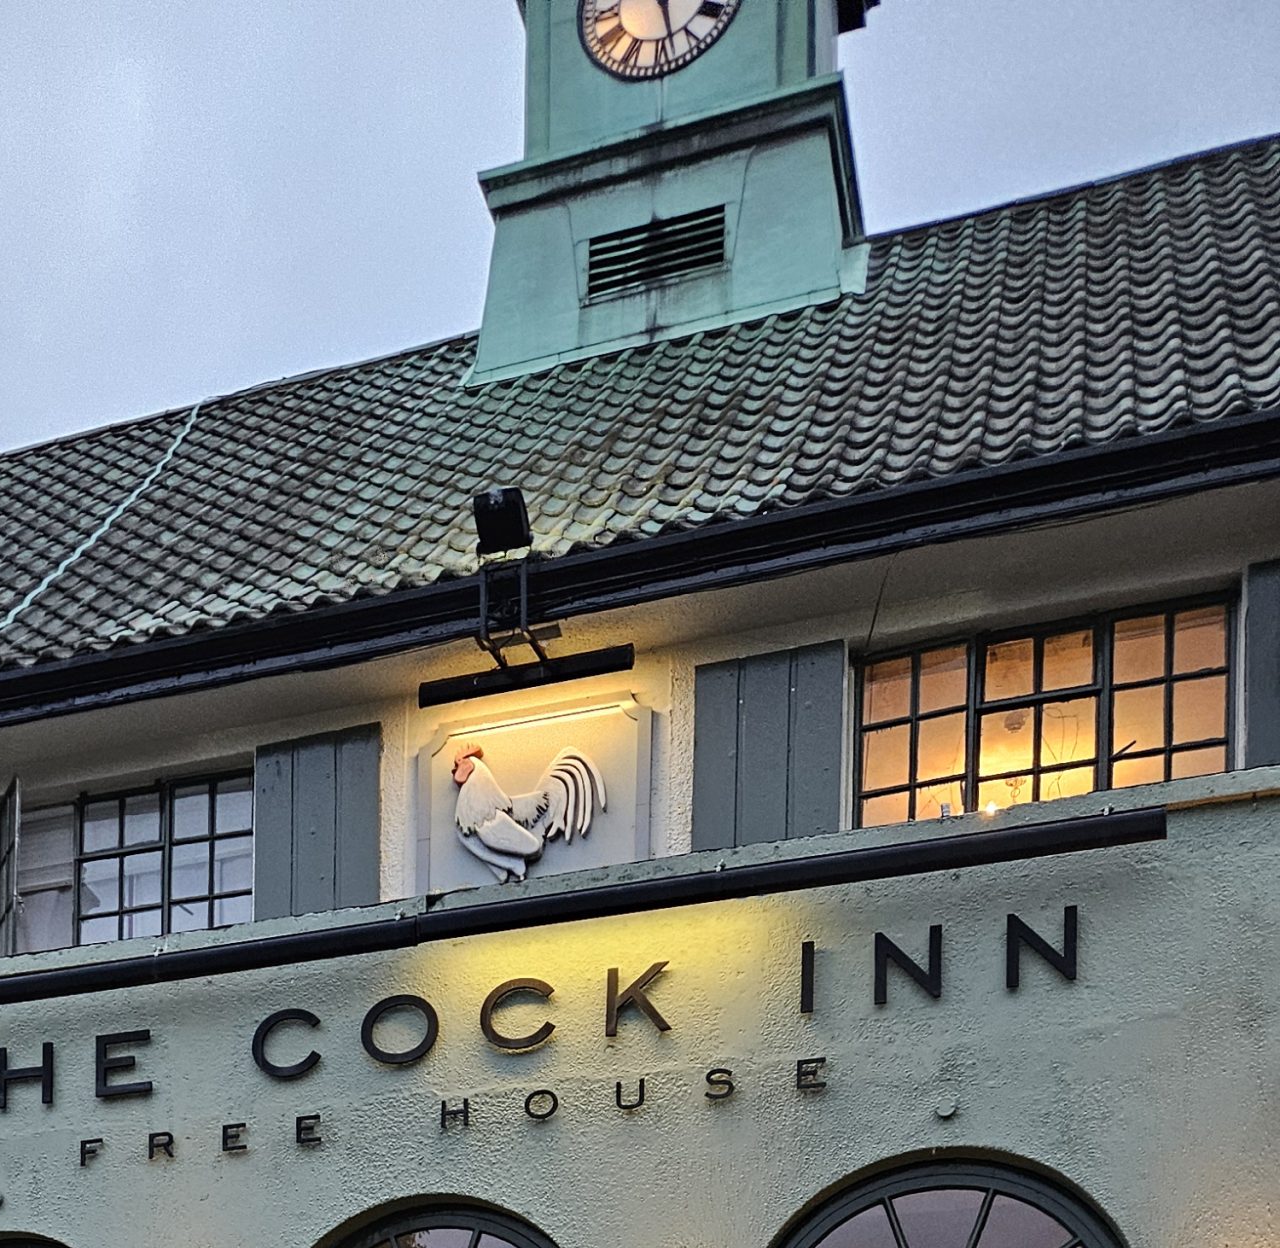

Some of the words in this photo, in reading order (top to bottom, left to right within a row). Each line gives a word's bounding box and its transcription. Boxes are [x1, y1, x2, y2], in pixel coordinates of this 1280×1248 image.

[252, 960, 673, 1080] COCK
[799, 905, 1078, 1015] INN
[80, 1114, 321, 1168] FREE
[440, 1056, 827, 1131] HOUSE
